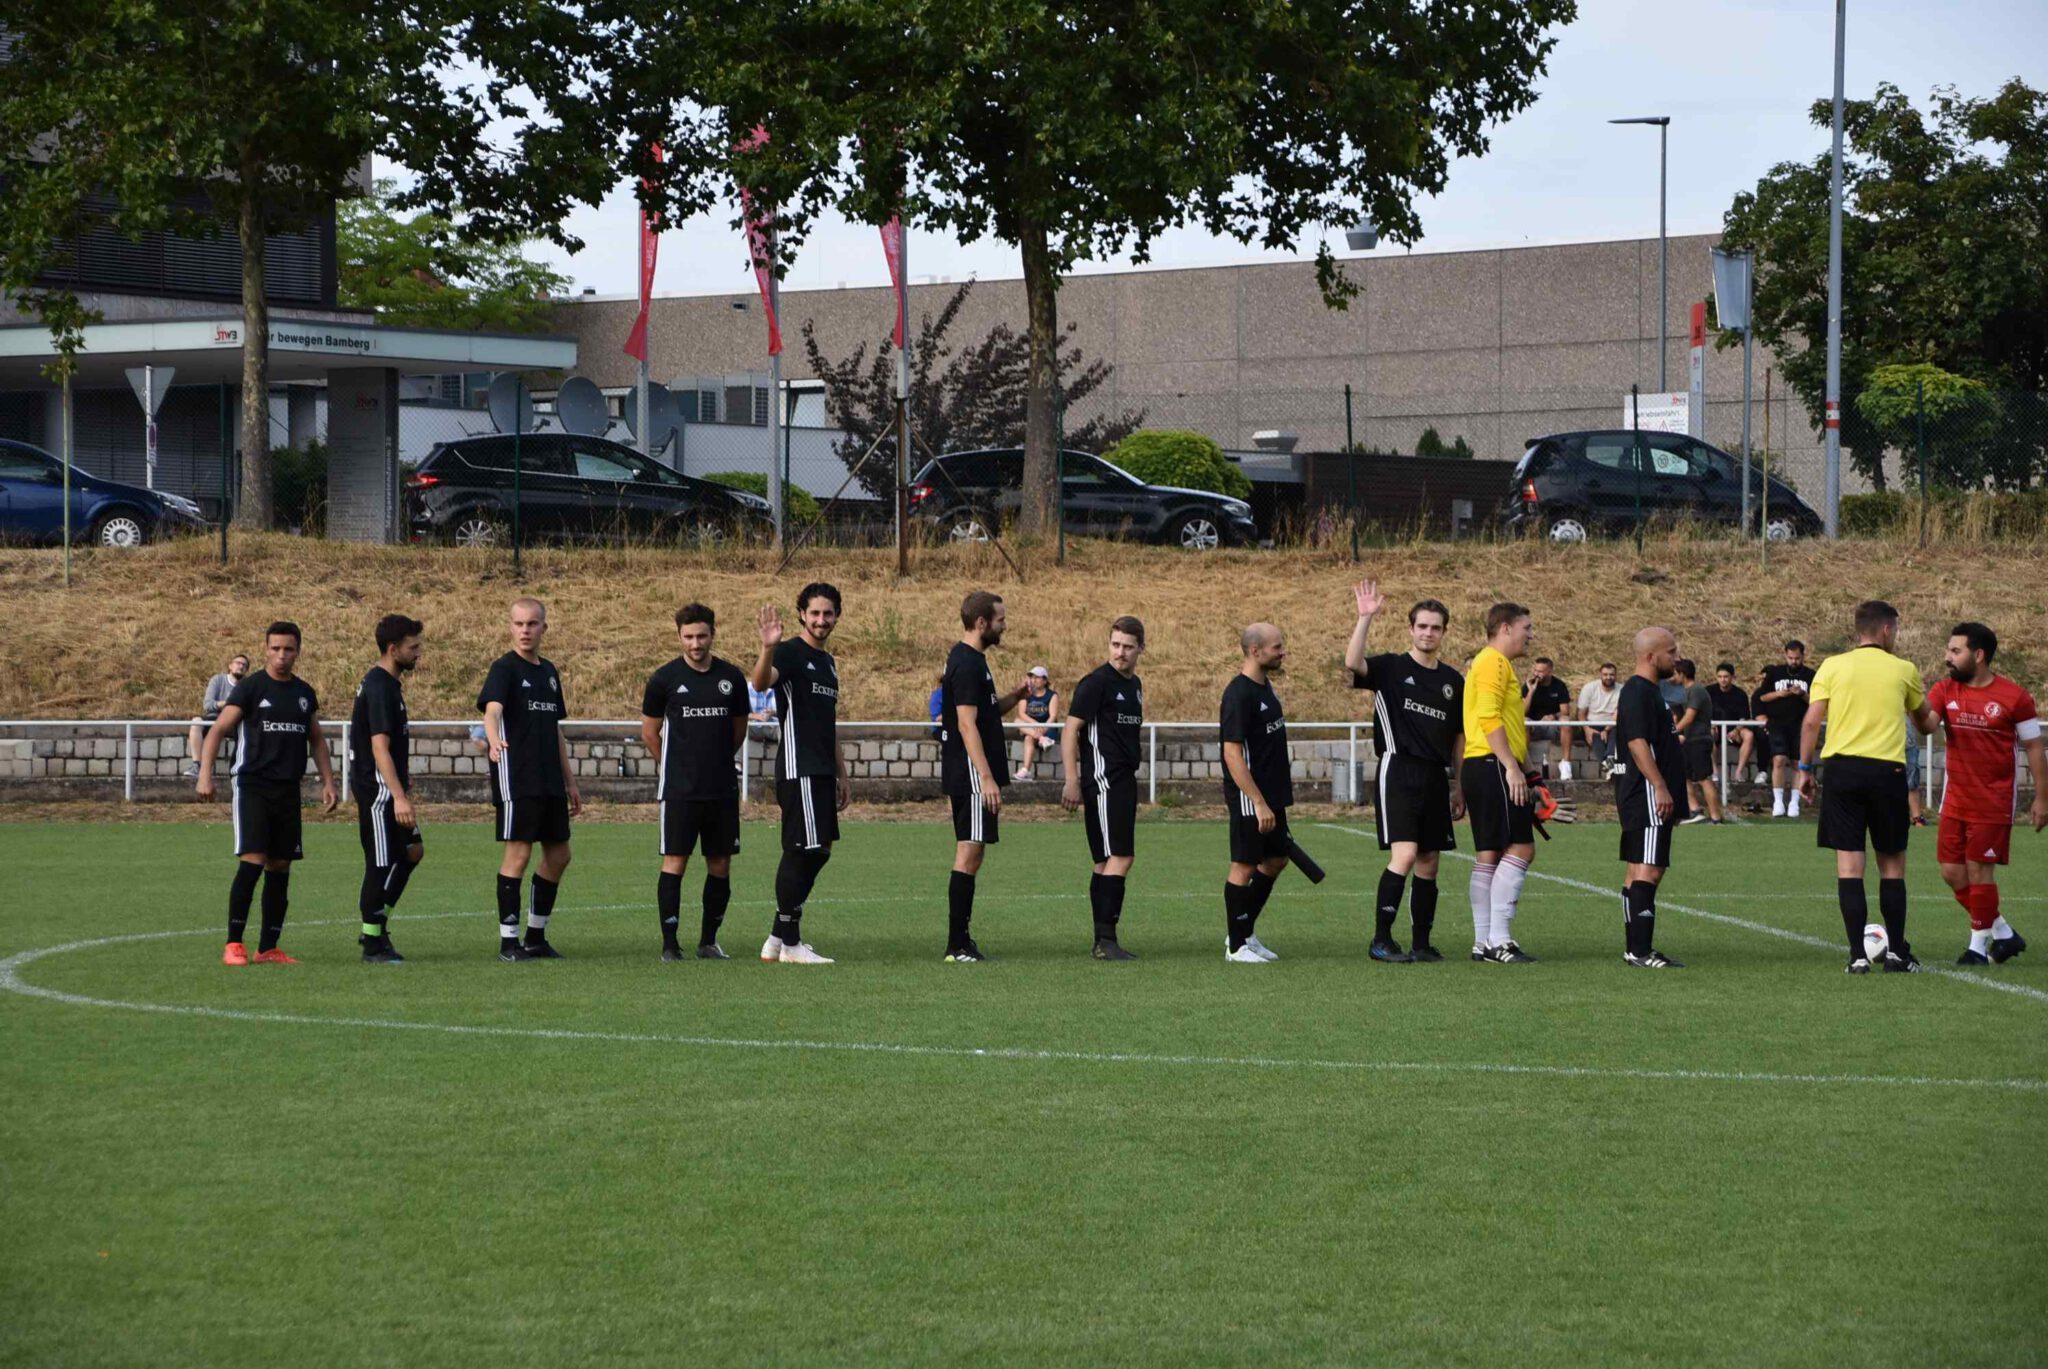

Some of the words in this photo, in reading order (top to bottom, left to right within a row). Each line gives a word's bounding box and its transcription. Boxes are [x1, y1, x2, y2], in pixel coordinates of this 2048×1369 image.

[277, 332, 323, 346] bewegen
[325, 335, 370, 350] Bamberg
[682, 706, 728, 718] ECKERTS
[1404, 698, 1446, 720] ECKERTS
[262, 720, 306, 733] ECKERTS
